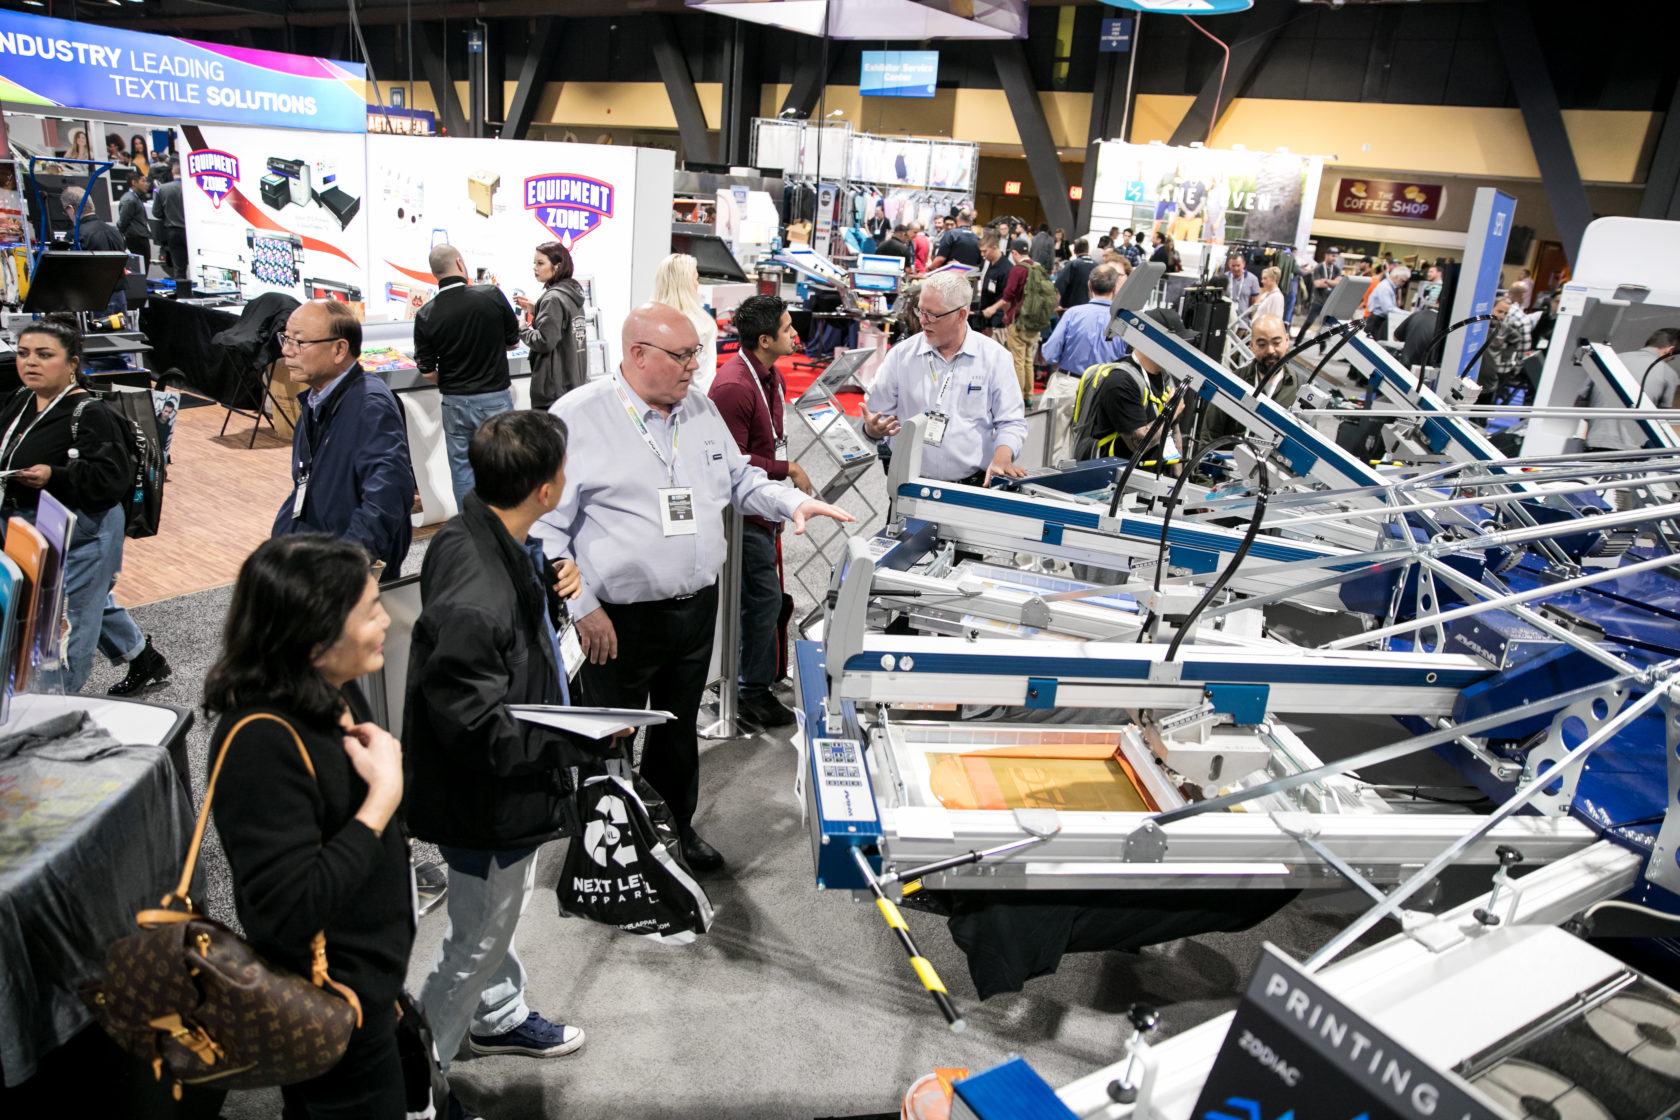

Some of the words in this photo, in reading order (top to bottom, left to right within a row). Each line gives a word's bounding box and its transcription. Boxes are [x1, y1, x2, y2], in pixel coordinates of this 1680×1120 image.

[0, 31, 121, 69] NDUSTRY
[130, 50, 225, 82] LEADING
[883, 72, 912, 82] Center
[902, 63, 934, 73] Service
[109, 74, 201, 104] TEXTILE
[206, 86, 318, 115] SOLUTIONS
[189, 153, 238, 179] EQUIPMENT
[201, 175, 229, 193] ZONE
[527, 179, 610, 212] EQUIPMENT
[1159, 186, 1198, 205] ANE
[1343, 197, 1390, 212] COFFEE
[1392, 200, 1430, 215] SHOP
[546, 207, 590, 231] ZONE
[1307, 393, 1315, 402] 6
[573, 876, 612, 893] NEXT
[617, 873, 657, 894] LEL
[1265, 972, 1441, 1116] PRINTING
[1237, 1029, 1302, 1088] ZODIAC
